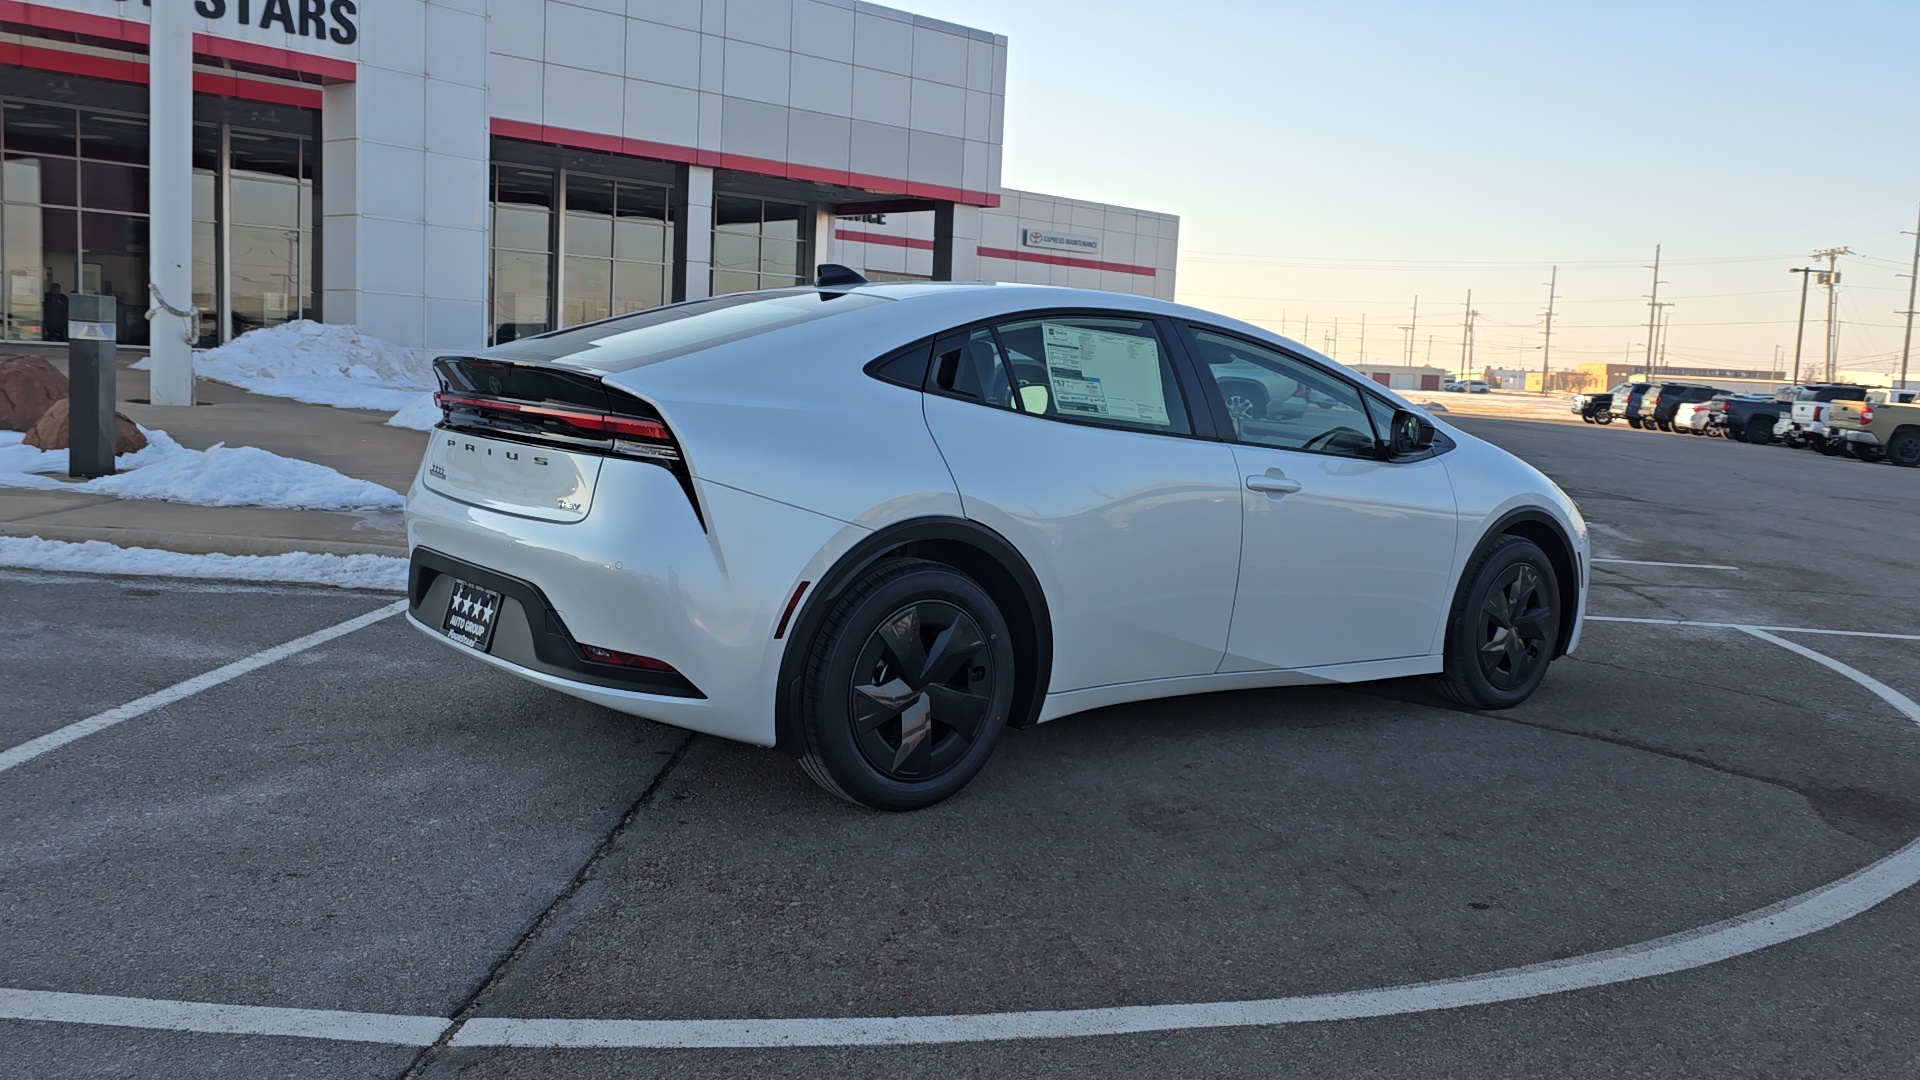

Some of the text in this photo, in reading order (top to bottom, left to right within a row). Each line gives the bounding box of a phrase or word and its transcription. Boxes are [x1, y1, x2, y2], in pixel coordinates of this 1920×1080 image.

[1044, 235, 1098, 248] EXPRESS MAINTENANCE
[447, 439, 549, 466] PRIUS
[450, 615, 485, 636] AUTO GROUP
